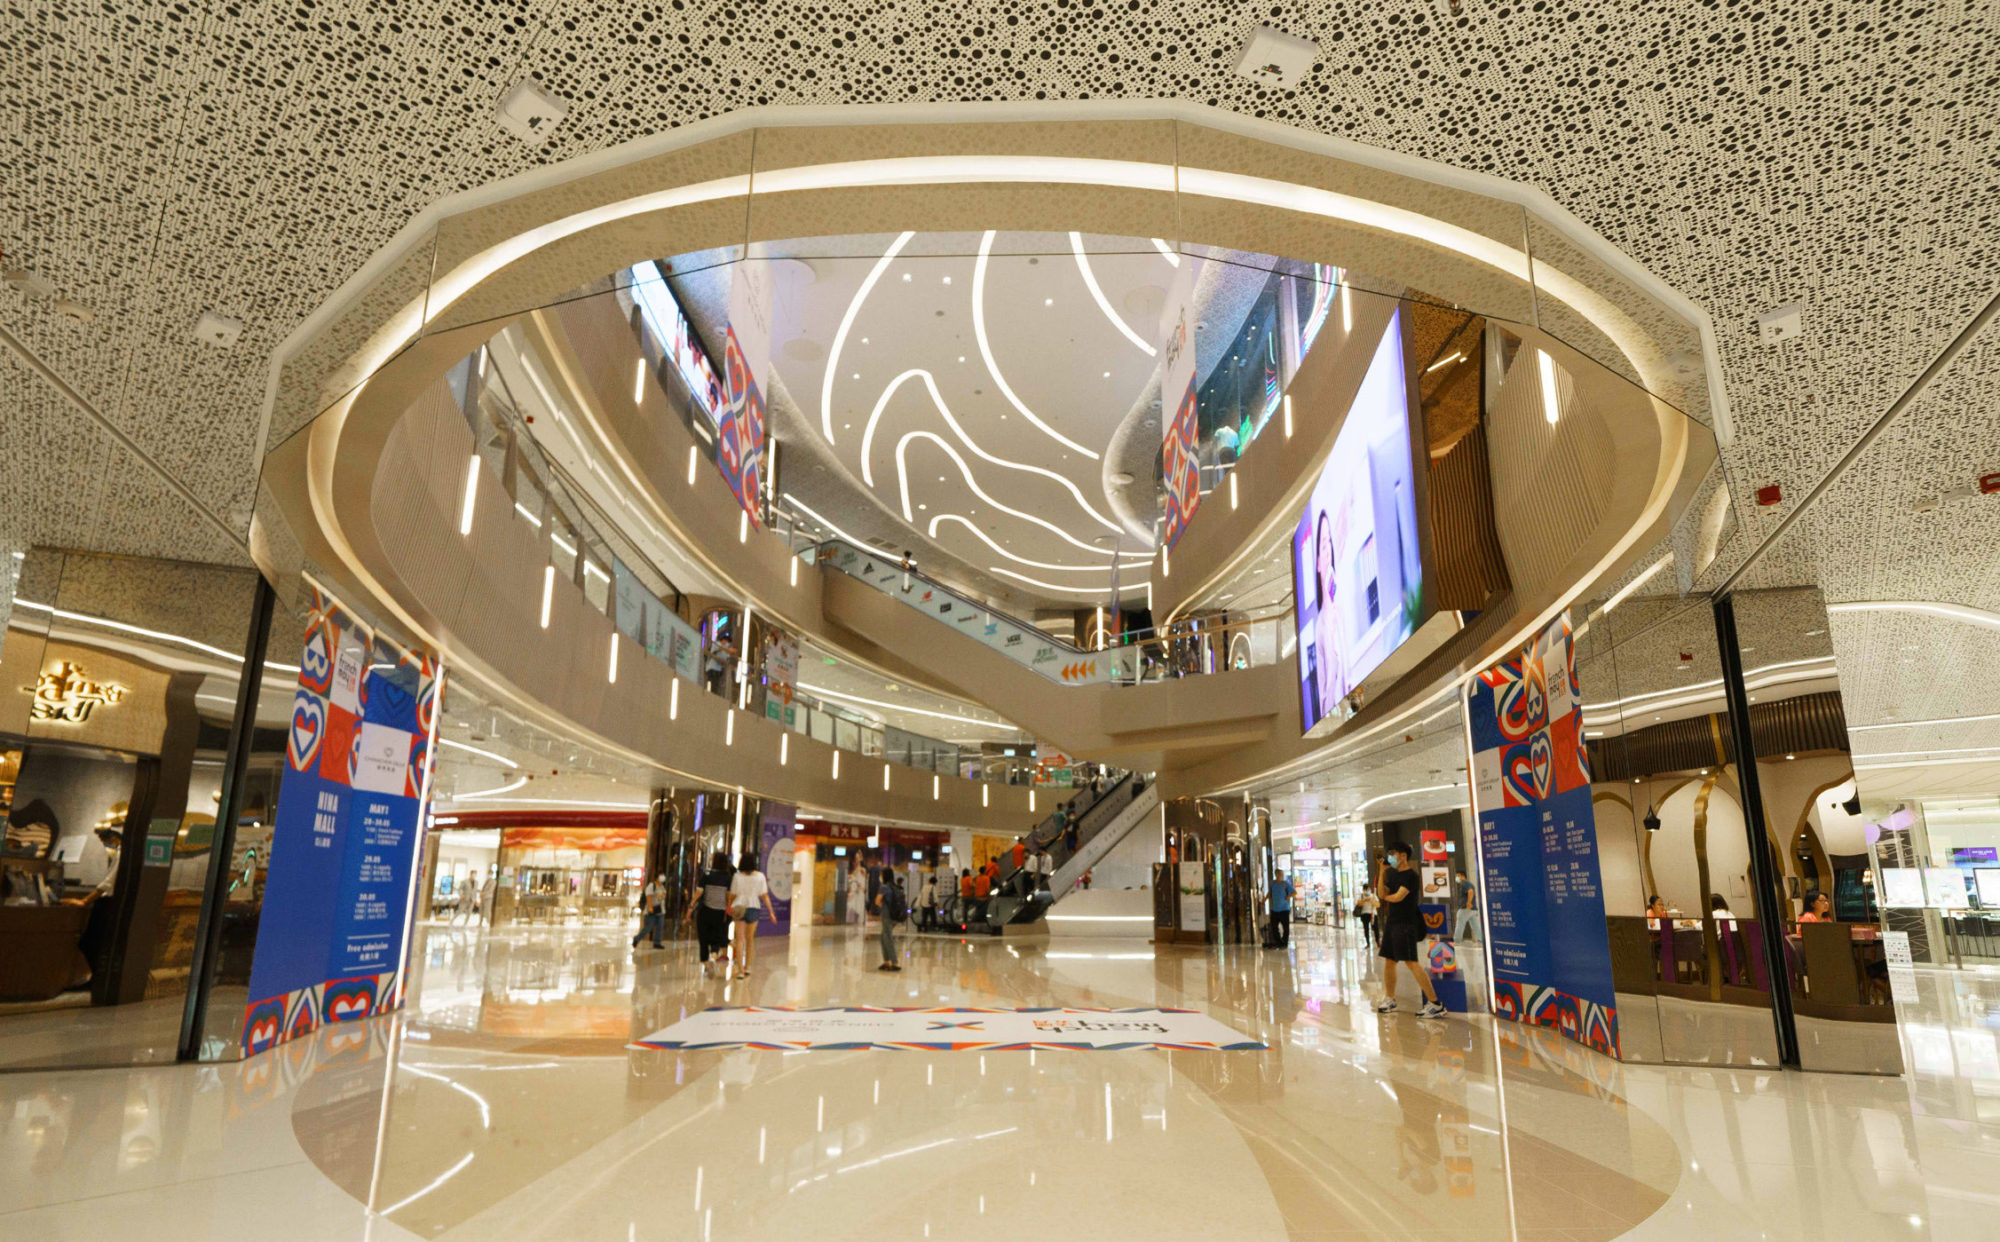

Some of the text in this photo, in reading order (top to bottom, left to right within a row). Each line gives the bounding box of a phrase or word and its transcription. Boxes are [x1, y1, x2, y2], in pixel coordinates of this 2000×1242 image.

[1548, 664, 1565, 687] french
[313, 812, 336, 835] MALL
[347, 942, 388, 952] Free admission
[1503, 949, 1527, 958] admission
